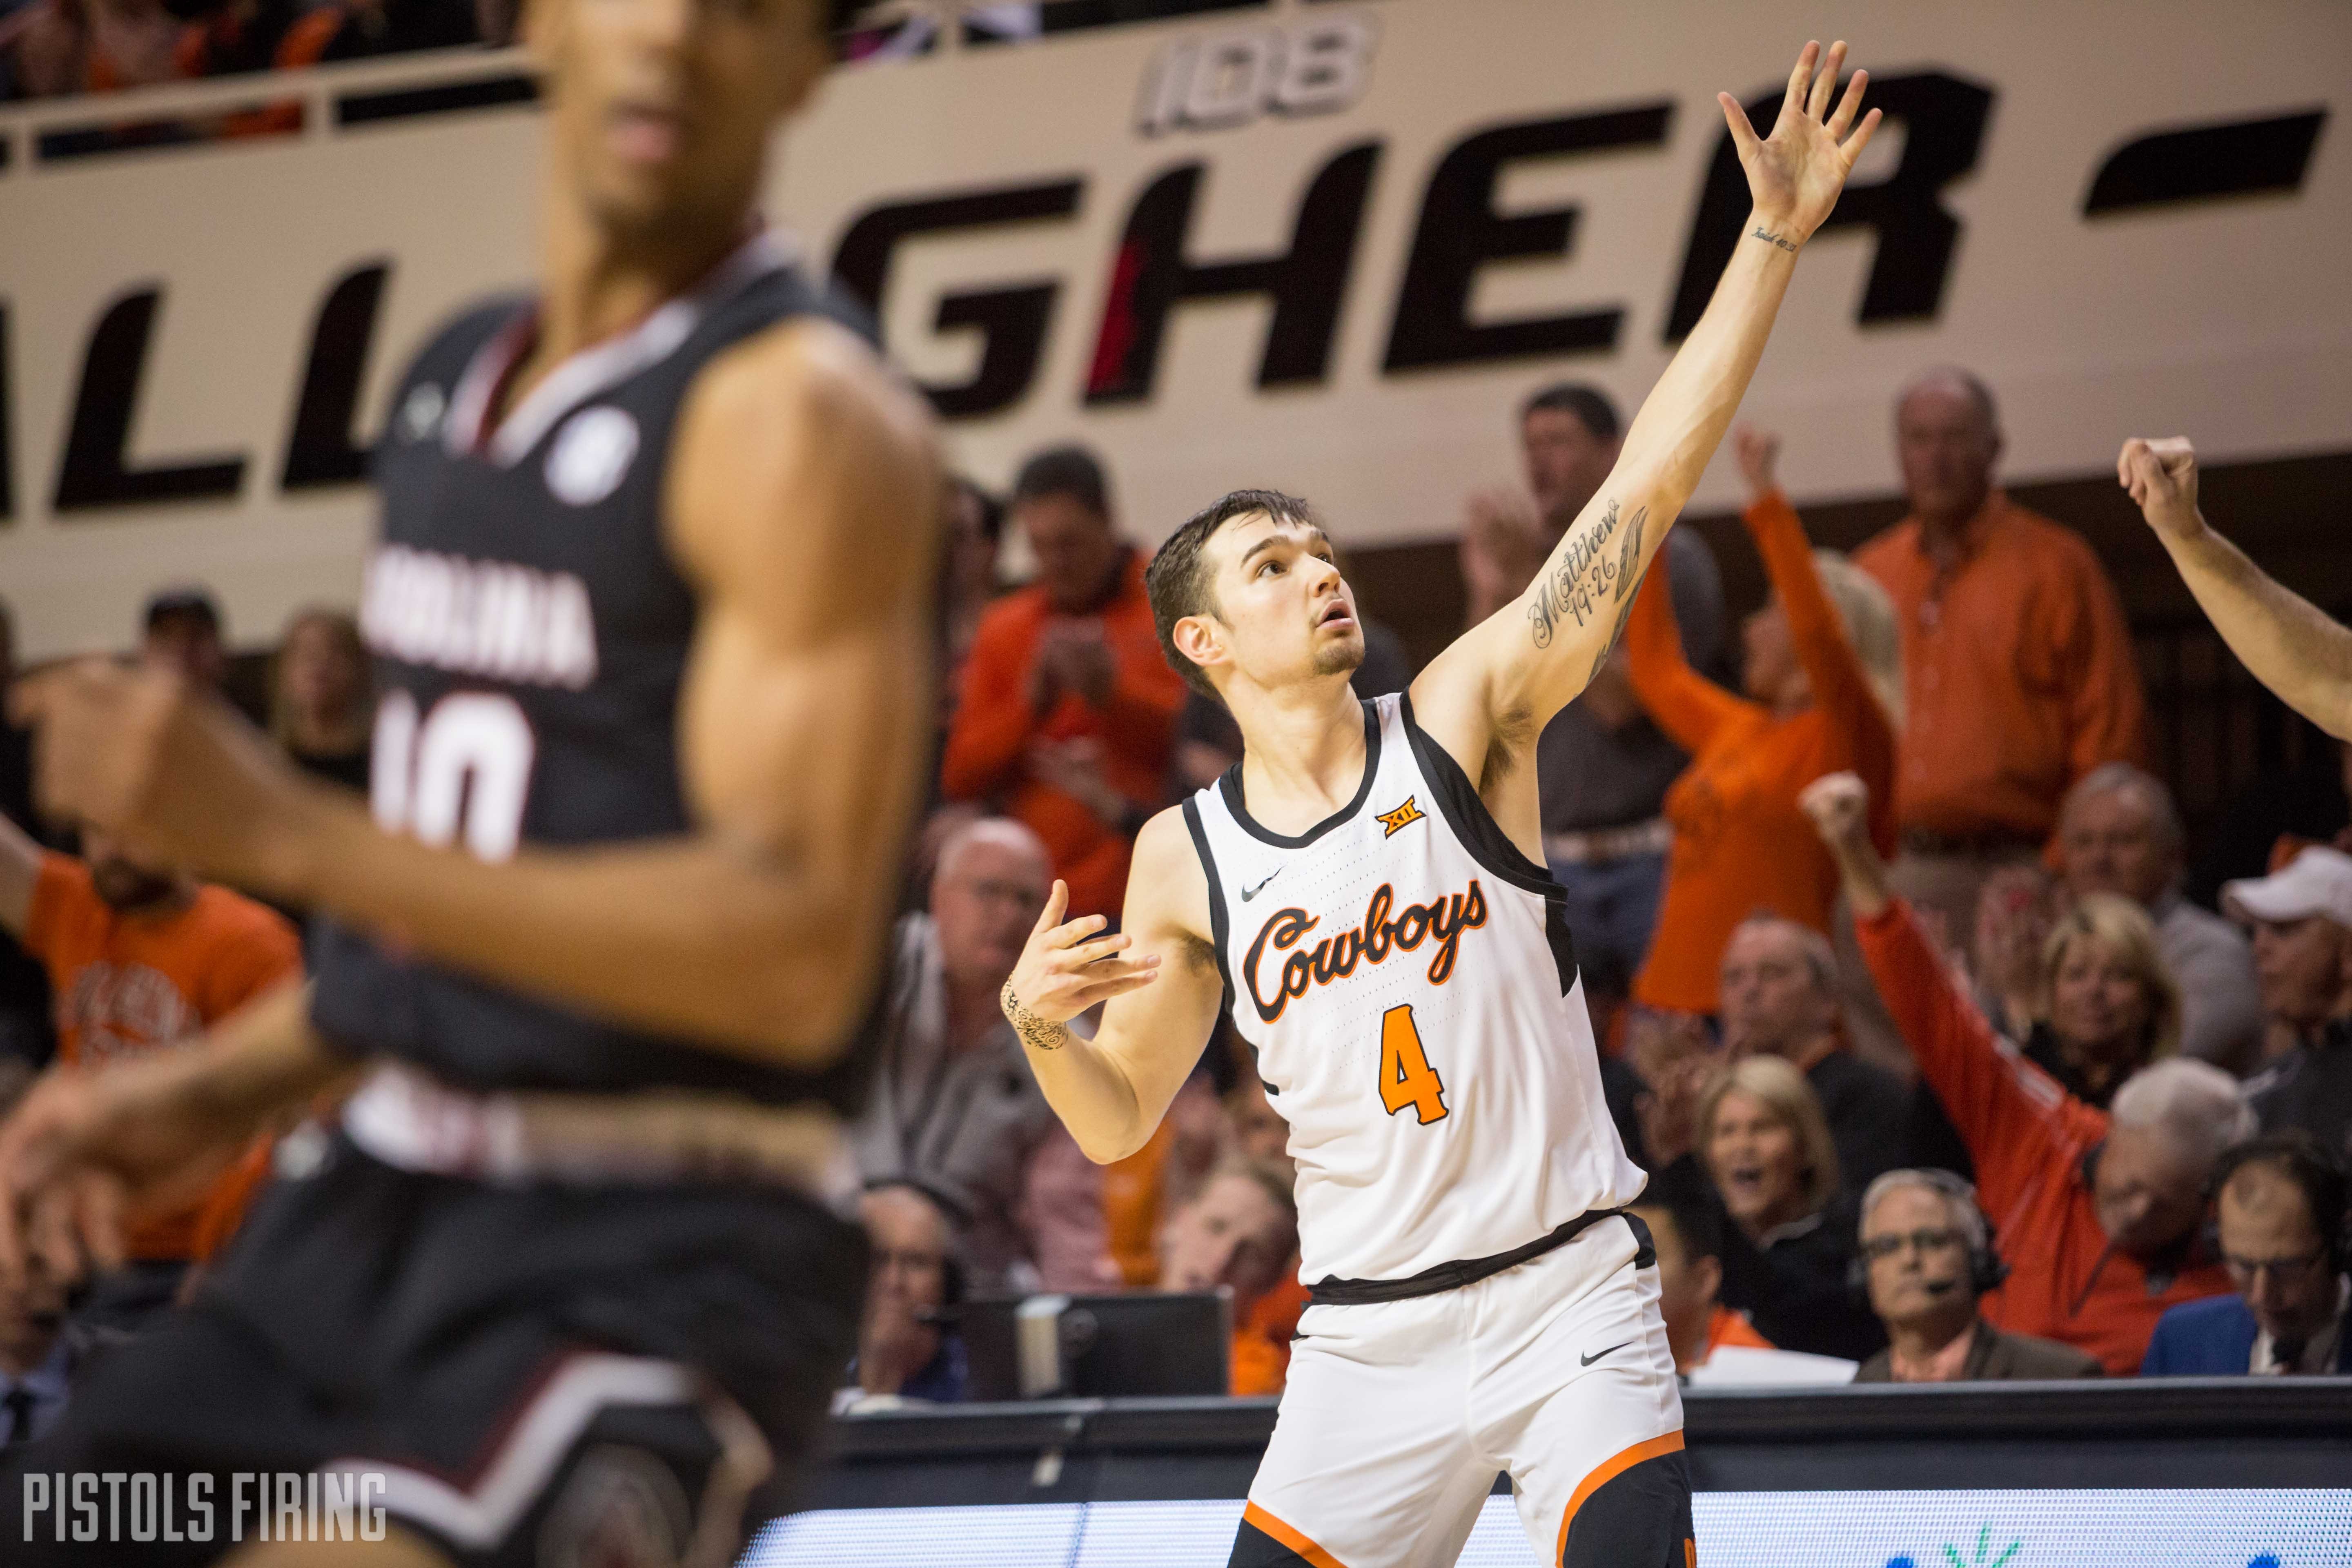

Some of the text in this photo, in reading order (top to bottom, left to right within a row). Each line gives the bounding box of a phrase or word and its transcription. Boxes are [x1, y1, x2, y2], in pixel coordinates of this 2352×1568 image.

[1136, 13, 1375, 136] 108
[1528, 497, 1619, 648] Matthew
[1570, 555, 1616, 626] 19:26
[1375, 795, 1426, 839] XII
[1243, 880, 1488, 1023] Cowboys
[1379, 1004, 1449, 1125] 4
